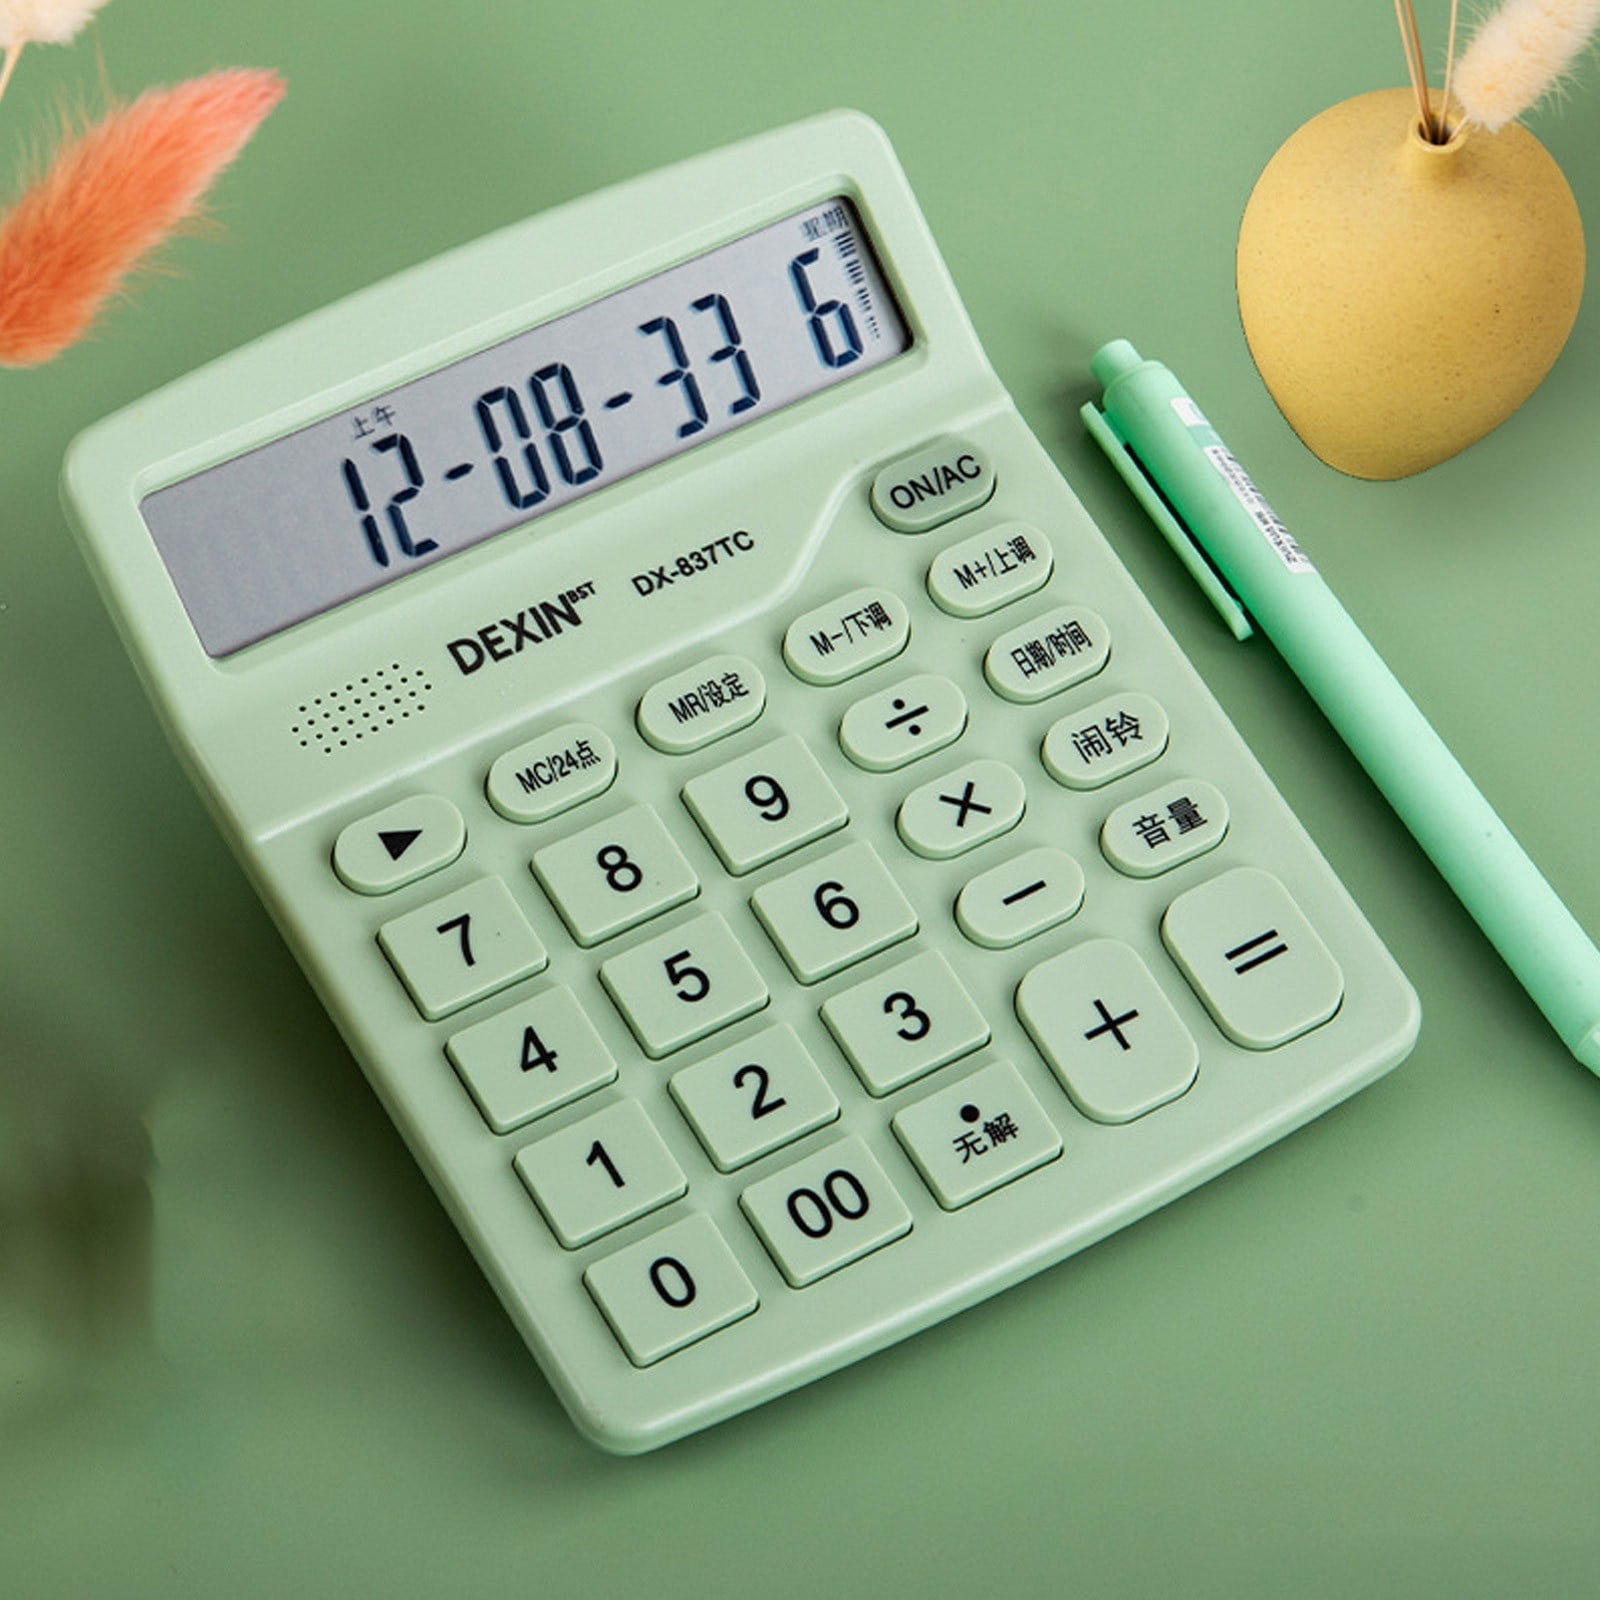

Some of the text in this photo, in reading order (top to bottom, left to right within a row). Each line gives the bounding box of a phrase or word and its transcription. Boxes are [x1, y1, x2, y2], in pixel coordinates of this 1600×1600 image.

[789, 247, 864, 369] 6
[354, 405, 397, 440] 上午
[889, 454, 982, 510] ON/AC
[631, 530, 755, 597] DX-837TC
[953, 535, 1037, 590] M+/上调
[446, 581, 596, 676] DEXIN BST
[1010, 620, 1093, 680] 日期/时间
[667, 671, 751, 725] MR/设定
[1071, 711, 1144, 764] 闹铃
[515, 739, 601, 795] MC/24点
[745, 776, 789, 821] 9
[1132, 796, 1209, 850] 音量
[597, 845, 642, 892] 8
[814, 882, 859, 929] 6
[437, 914, 475, 966] 7
[664, 950, 710, 1002] 5
[884, 992, 930, 1041] 3
[521, 1026, 557, 1072] 4
[734, 1065, 786, 1119] 2
[586, 1141, 625, 1187] 1
[952, 1112, 1020, 1164] 无解
[787, 1170, 869, 1238] 00
[650, 1257, 696, 1307] 0
